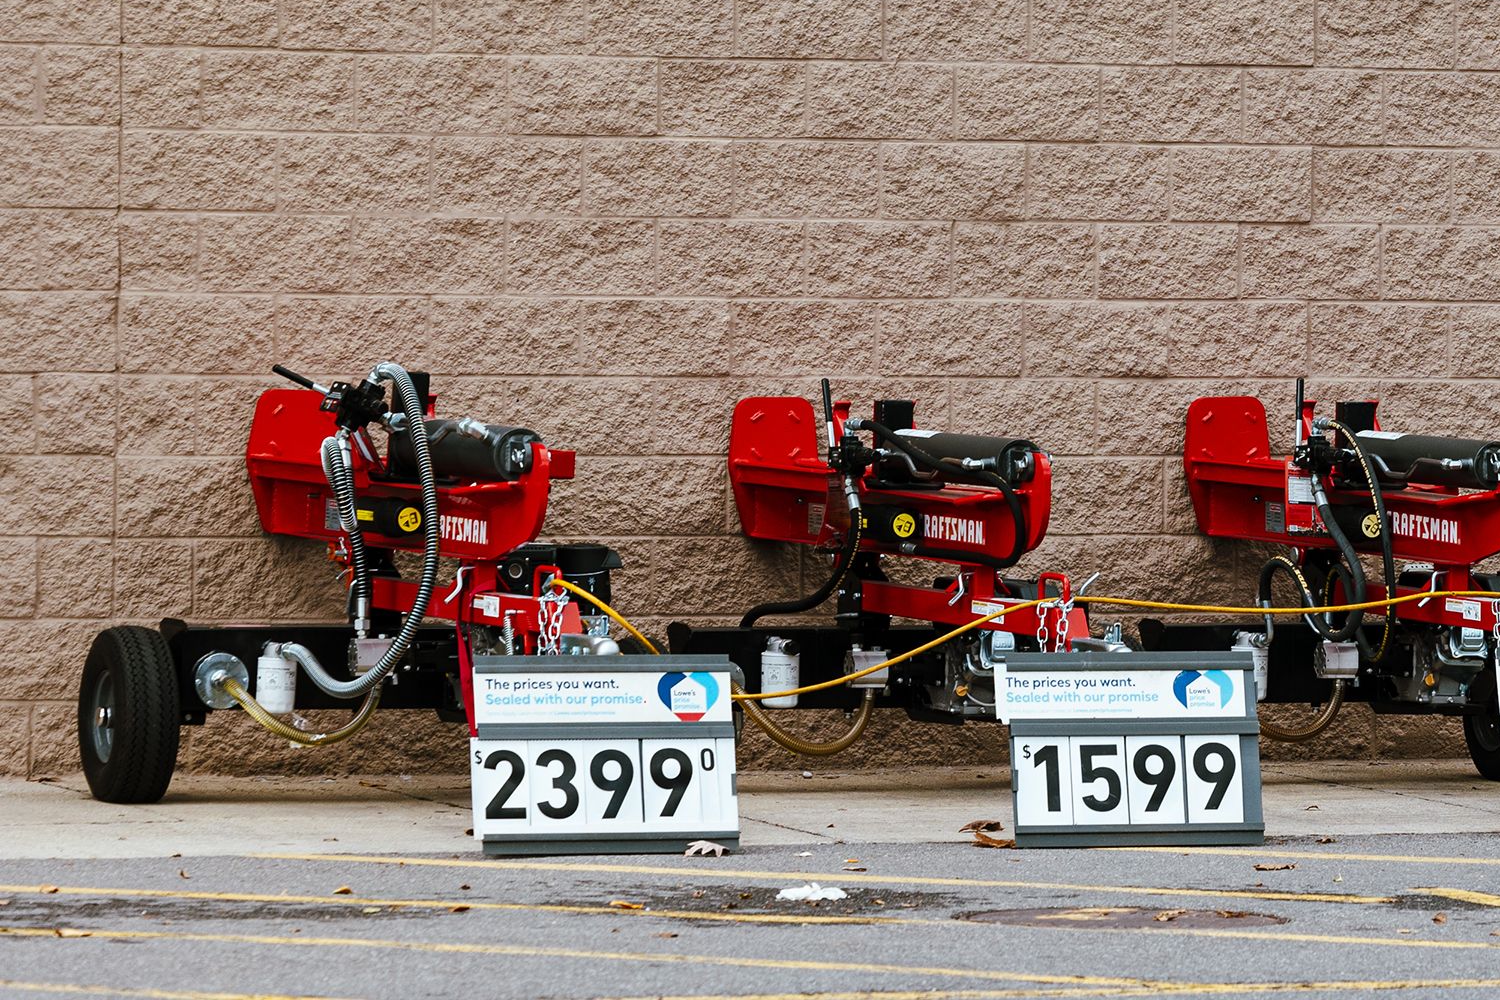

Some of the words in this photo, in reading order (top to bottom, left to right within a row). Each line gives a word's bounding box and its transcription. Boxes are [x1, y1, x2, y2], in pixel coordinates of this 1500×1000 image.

[440, 515, 486, 544] AFTSMAN
[485, 679, 509, 690] The
[514, 680, 552, 692] prices
[556, 680, 581, 692] you
[584, 679, 619, 689] want.
[1005, 677, 1029, 688] The
[1033, 677, 1071, 690] prices
[1074, 678, 1098, 690] you
[1101, 677, 1135, 688] want.
[486, 693, 530, 705] Sealed
[533, 693, 563, 705] with
[566, 695, 588, 705] our
[591, 693, 647, 707] promise.
[1006, 692, 1050, 703] Sealed
[1053, 692, 1081, 703] with
[1084, 693, 1105, 703] our
